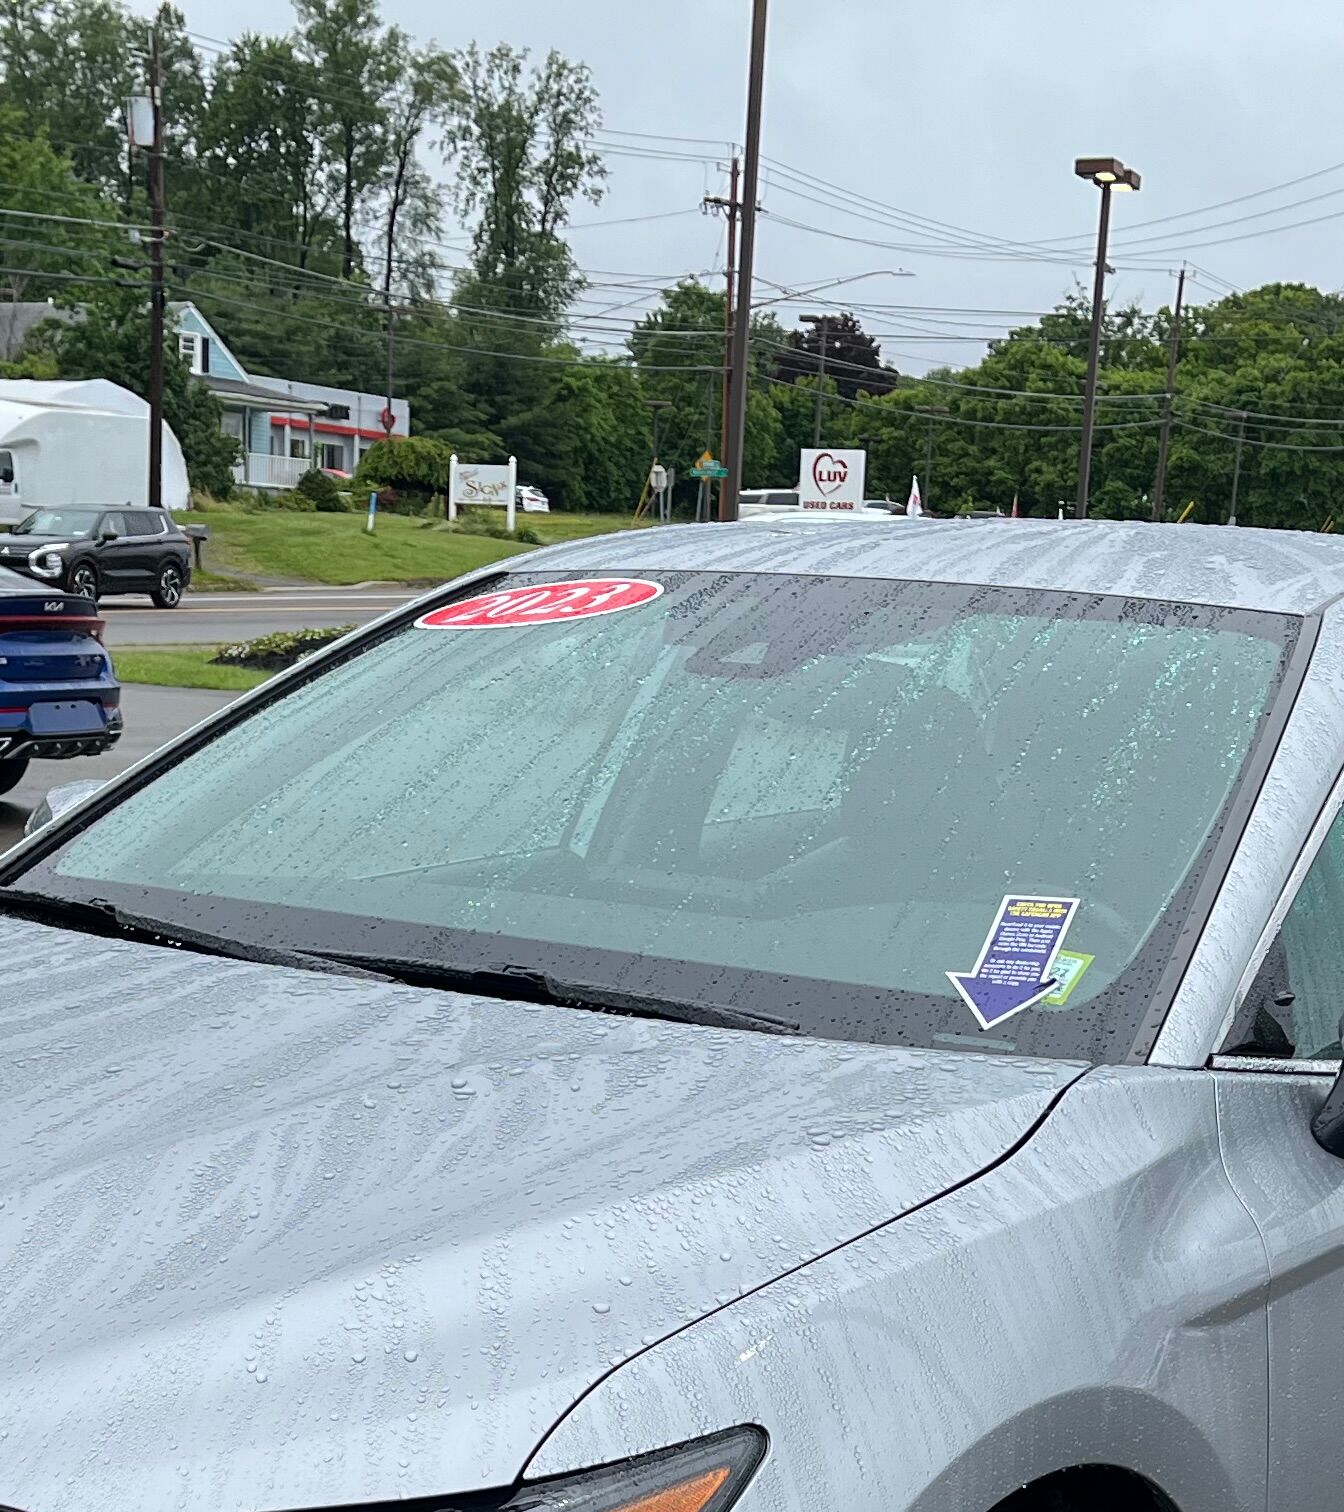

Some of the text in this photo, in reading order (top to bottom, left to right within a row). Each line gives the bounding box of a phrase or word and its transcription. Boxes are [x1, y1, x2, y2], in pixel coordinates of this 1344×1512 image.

[818, 470, 848, 483] LUV
[803, 501, 854, 510] USED CARS
[439, 583, 632, 624] 2023
